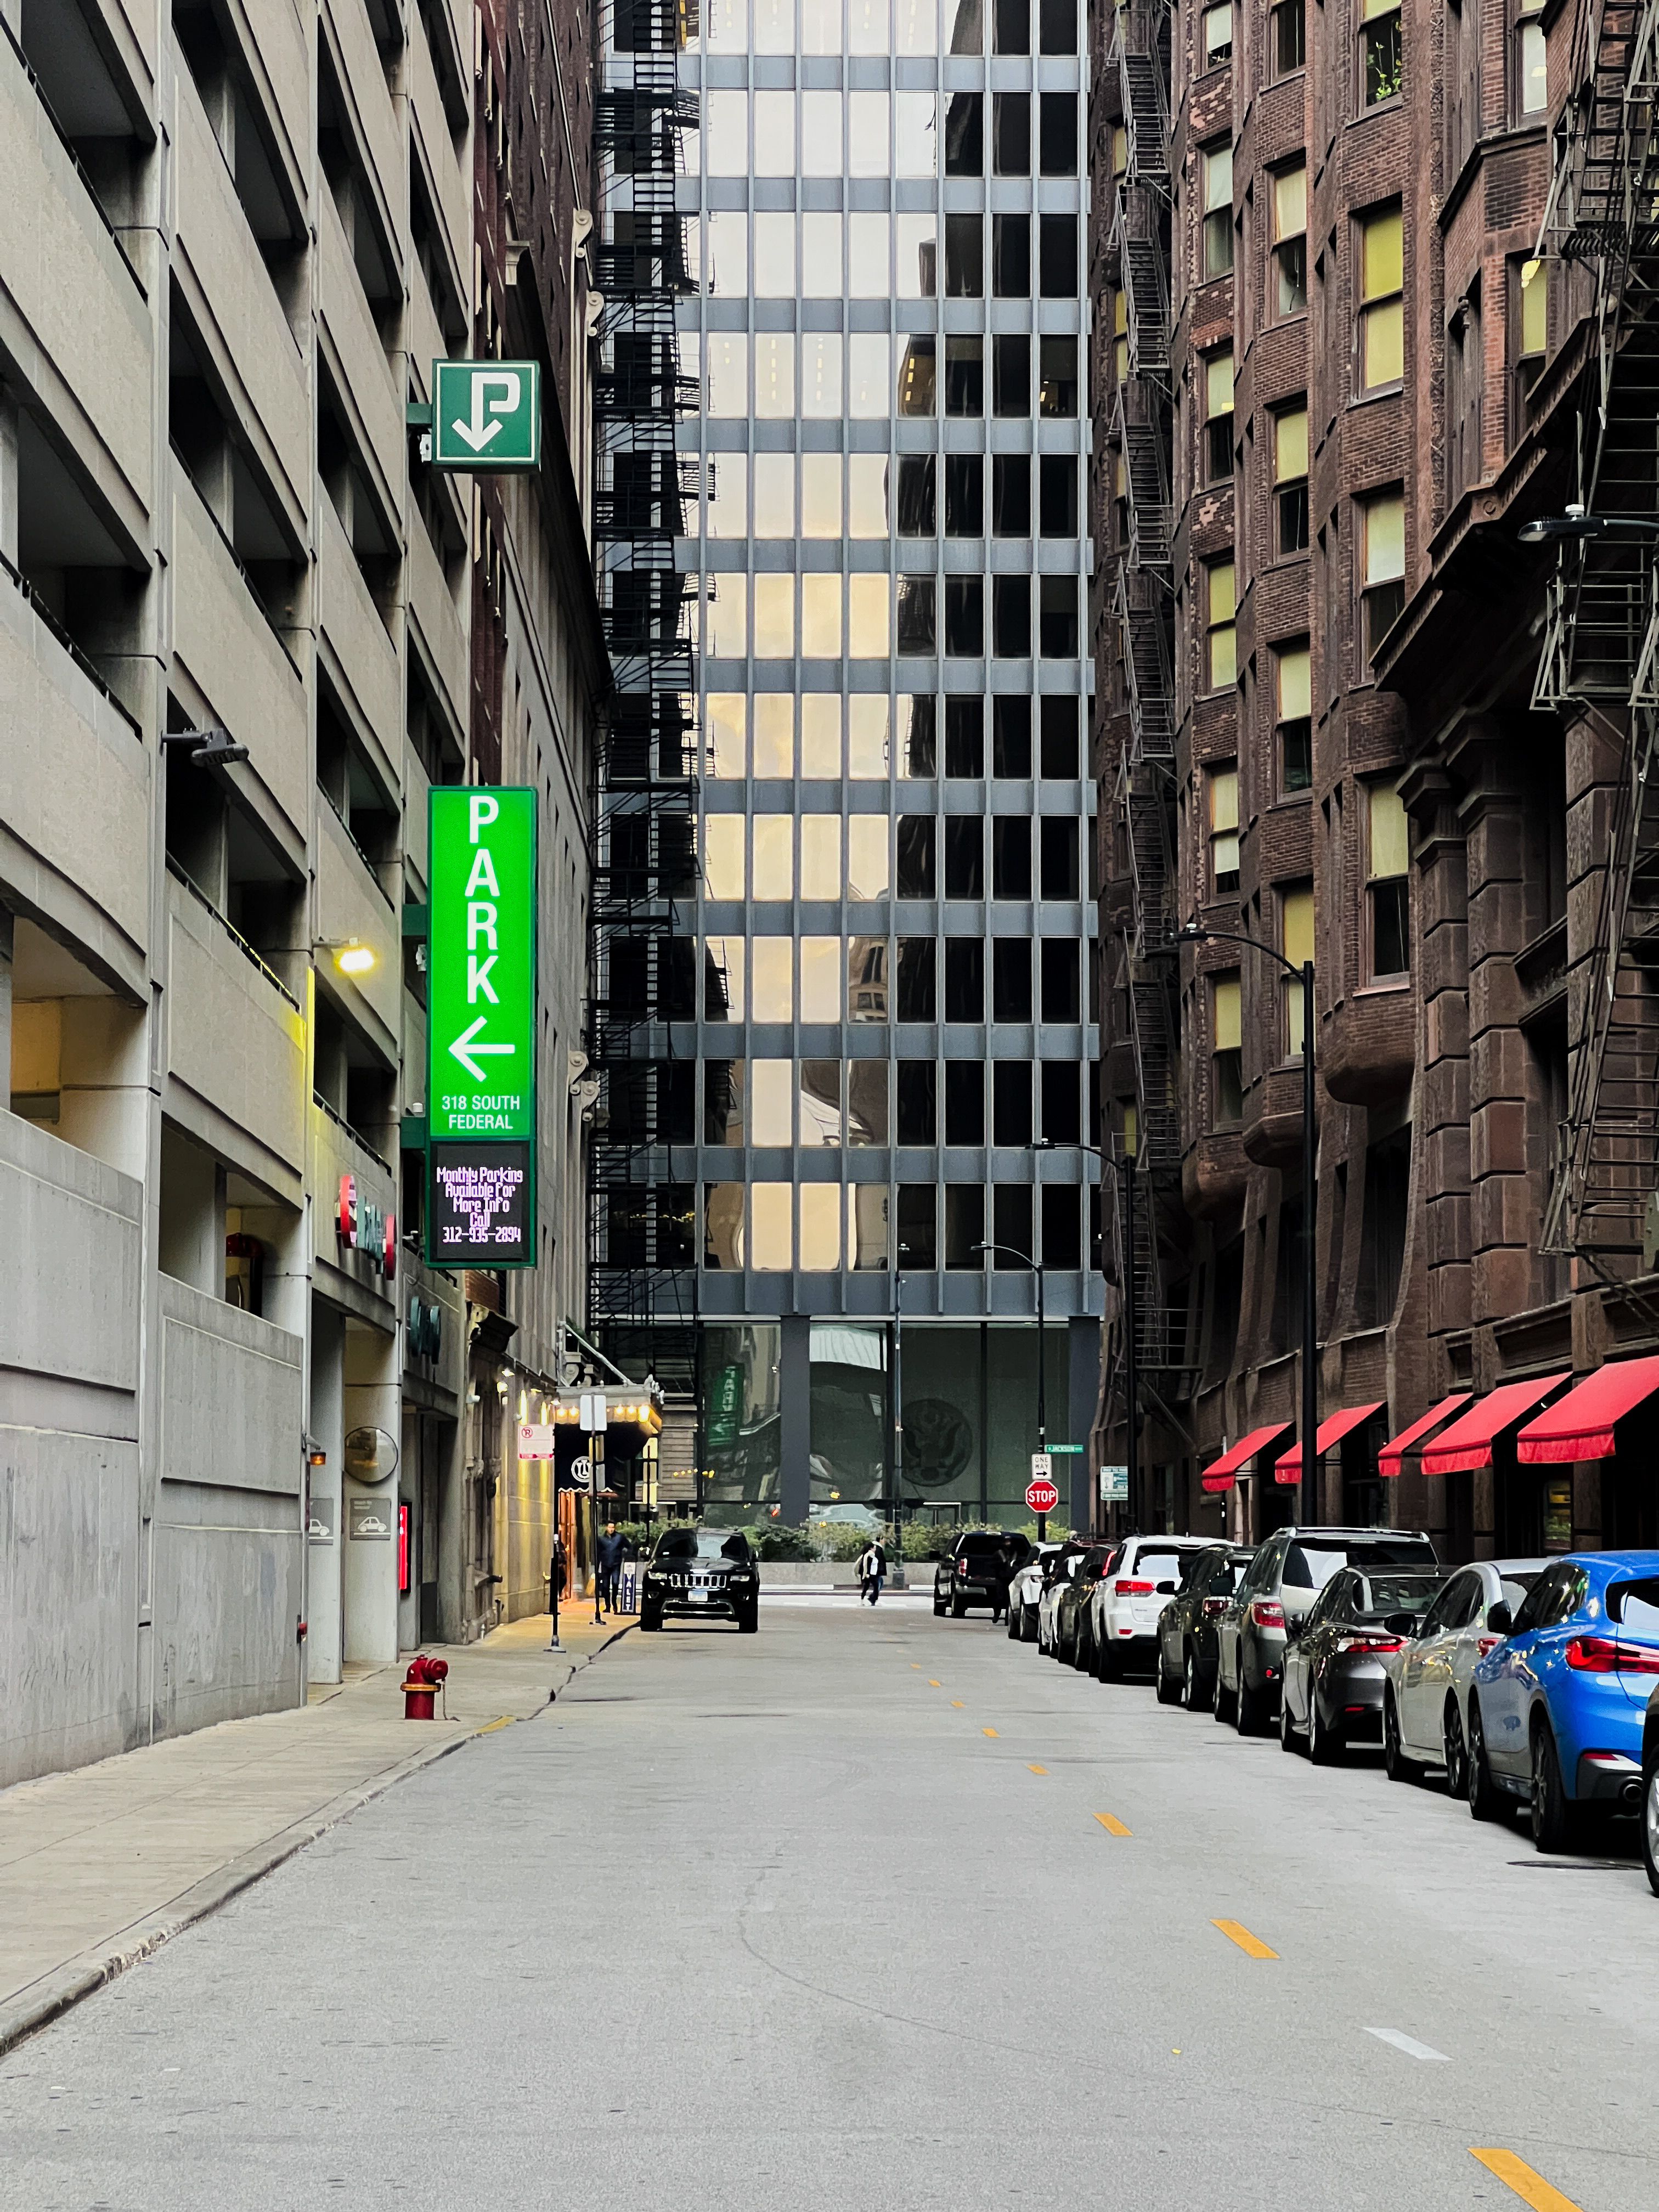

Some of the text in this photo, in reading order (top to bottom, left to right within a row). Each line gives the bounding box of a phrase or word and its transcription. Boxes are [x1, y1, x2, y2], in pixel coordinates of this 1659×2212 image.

[464, 795, 500, 1004] PARK
[442, 1095, 520, 1110] 318 SOUTH
[448, 1114, 514, 1130] FEDERAL
[436, 1166, 523, 1183] Monthly Parking
[445, 1182, 494, 1198] Available
[453, 1197, 510, 1212] More Info
[470, 1211, 490, 1227] Call
[442, 1226, 521, 1243] 312-935-2894
[1028, 1490, 1056, 1503] STOP
